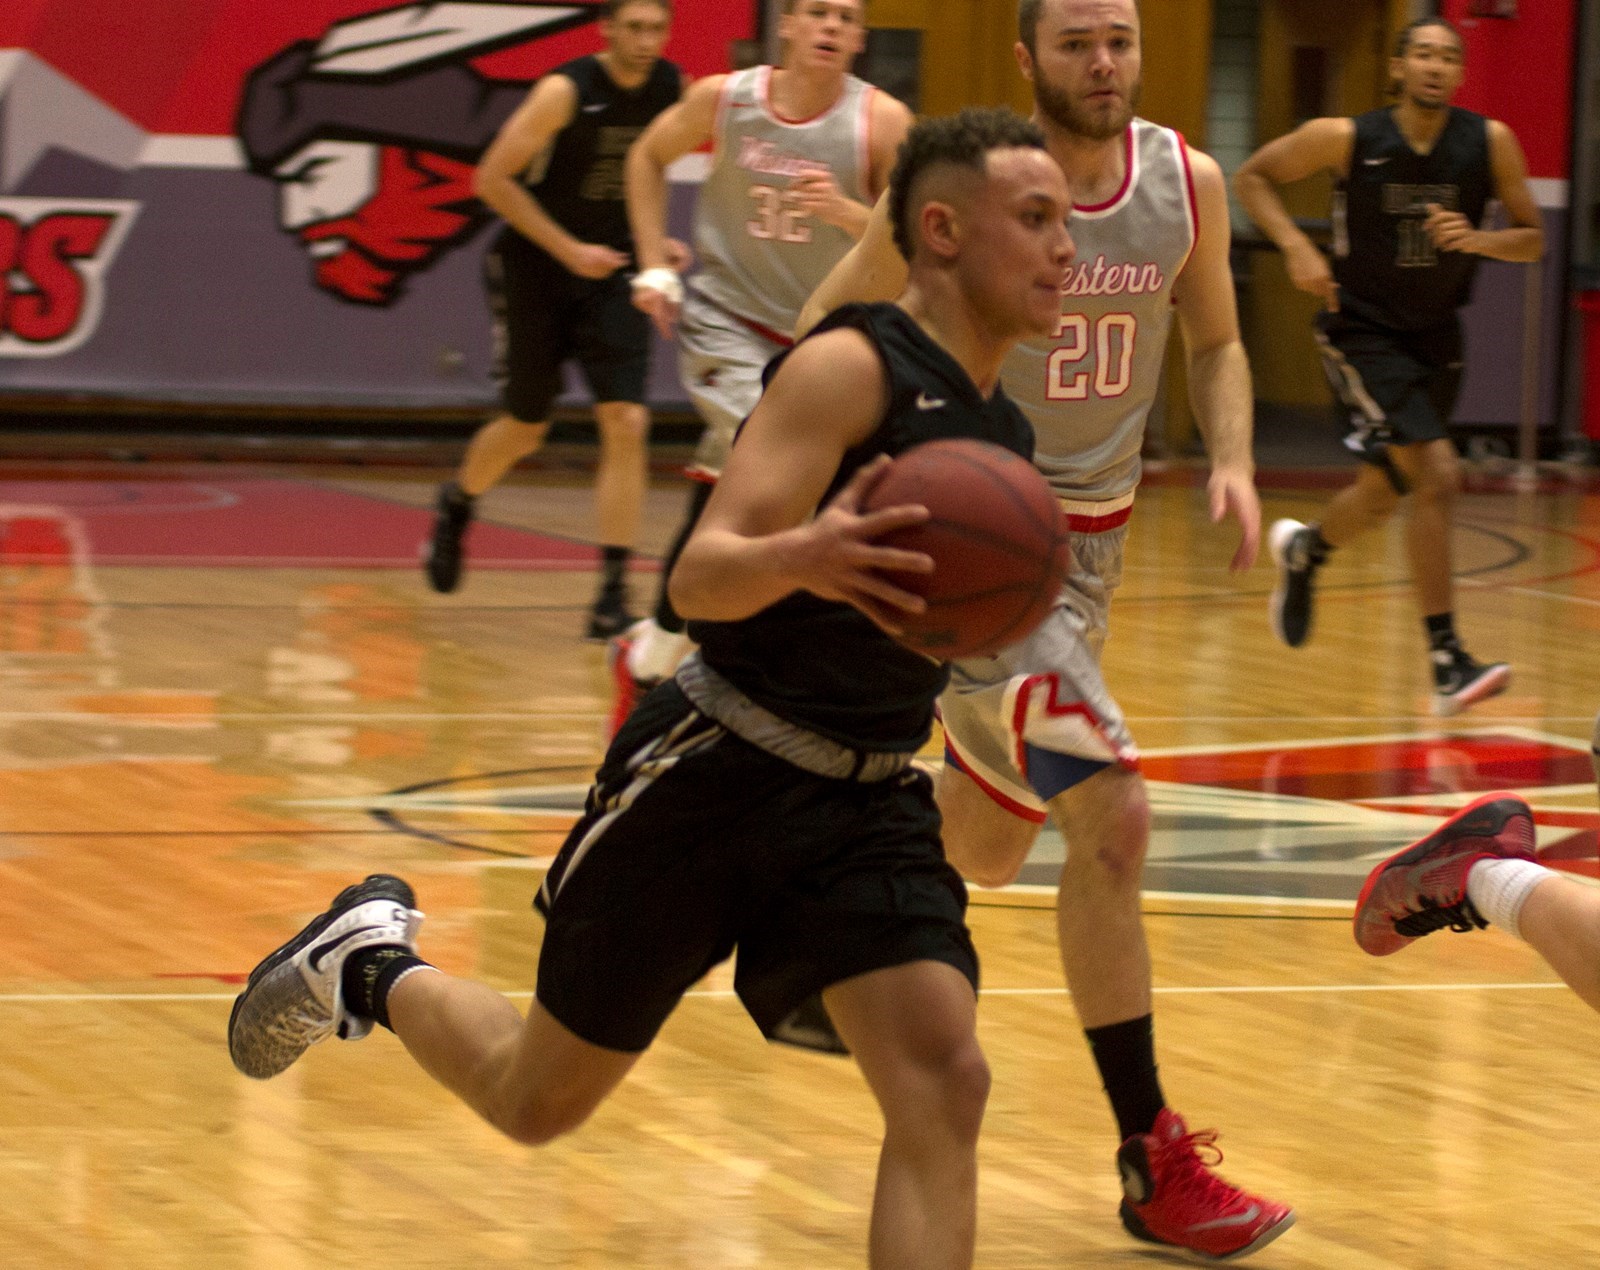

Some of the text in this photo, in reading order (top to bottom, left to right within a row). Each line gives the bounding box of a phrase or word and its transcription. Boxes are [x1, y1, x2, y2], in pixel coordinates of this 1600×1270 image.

[0, 211, 121, 344] S
[1059, 253, 1164, 297] estern
[1045, 311, 1137, 400] 20
